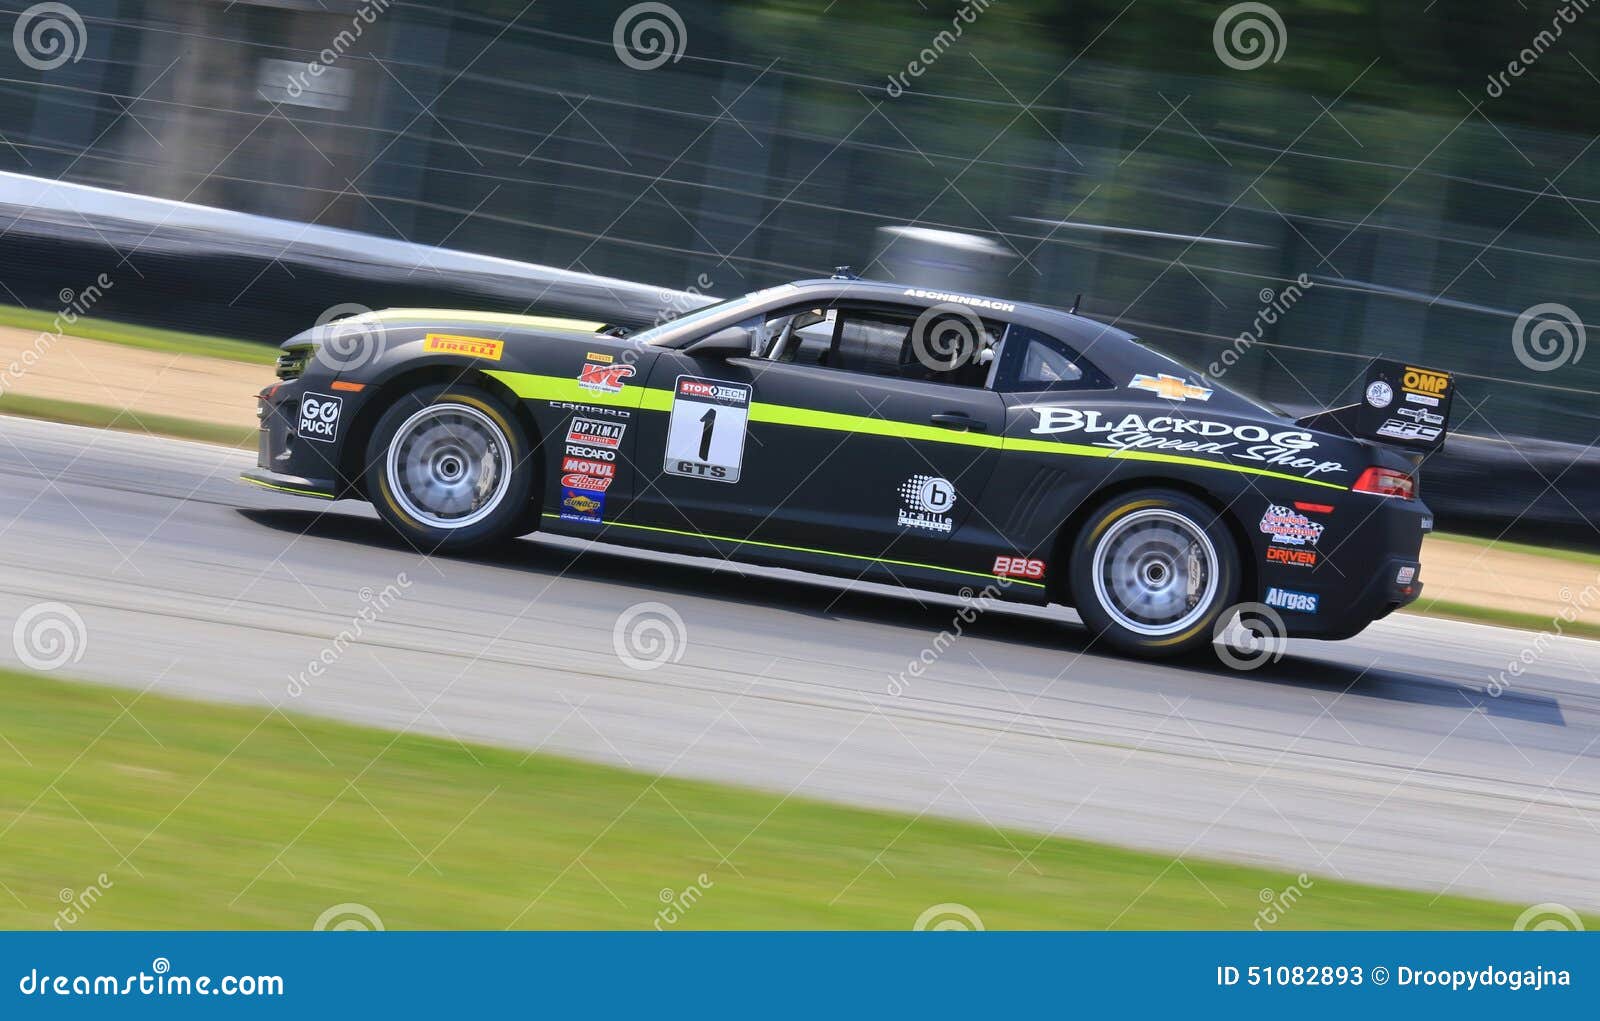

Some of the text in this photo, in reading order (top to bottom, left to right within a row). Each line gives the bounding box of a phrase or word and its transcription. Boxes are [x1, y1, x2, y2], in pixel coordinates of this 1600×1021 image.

[903, 288, 1016, 313] ASCHENBACH
[431, 337, 497, 356] PIRELLI
[682, 383, 709, 395] STOP
[720, 388, 745, 399] TECH
[1403, 371, 1448, 393] OMP
[303, 398, 338, 423] GO
[549, 401, 631, 418] CAMARO
[301, 418, 334, 436] PUCK
[574, 421, 620, 439] OPTIMA
[699, 408, 717, 462] 1
[1030, 406, 1319, 451] BLACKDOG
[1381, 419, 1442, 439] PFC
[565, 444, 616, 462] RECARO
[1092, 431, 1348, 478] Speed Shop
[563, 459, 614, 477] MOTUL
[677, 461, 726, 478] GTS
[564, 498, 601, 509] SUNOCO
[898, 508, 953, 525] braille
[1266, 547, 1317, 565] DRIVEN
[993, 556, 1045, 576] BBS
[1264, 587, 1317, 611] Airgas
